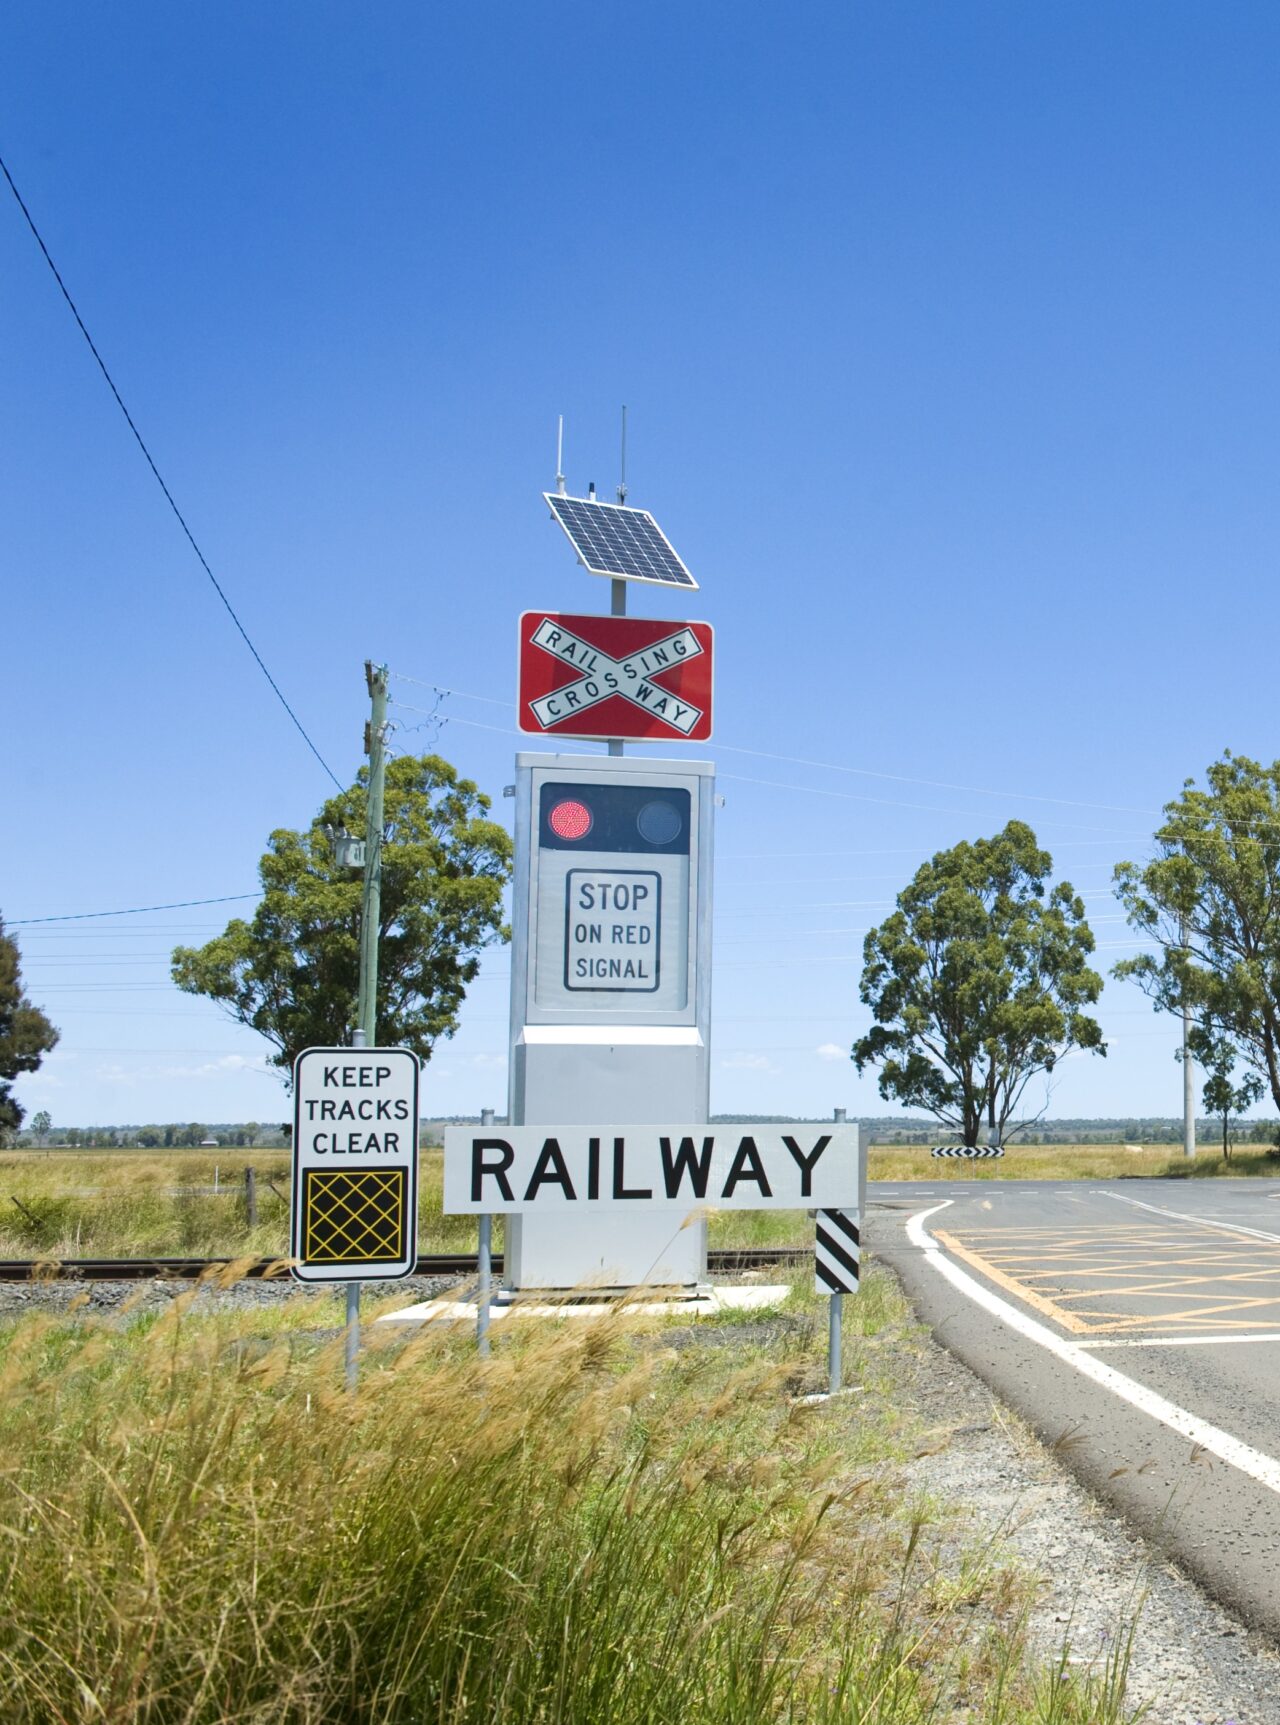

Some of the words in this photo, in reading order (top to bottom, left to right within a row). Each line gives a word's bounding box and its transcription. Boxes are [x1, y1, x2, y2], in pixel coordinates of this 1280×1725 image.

[546, 640, 687, 716] CROSSING
[579, 882, 649, 911] STOP
[575, 924, 602, 943] ON
[612, 925, 651, 945] RED
[575, 958, 649, 979] SIGNAL
[323, 1066, 392, 1088] KEEP
[305, 1099, 409, 1121] TRACKS
[312, 1132, 400, 1154] CLEAR
[471, 1135, 833, 1202] RAILWAY
